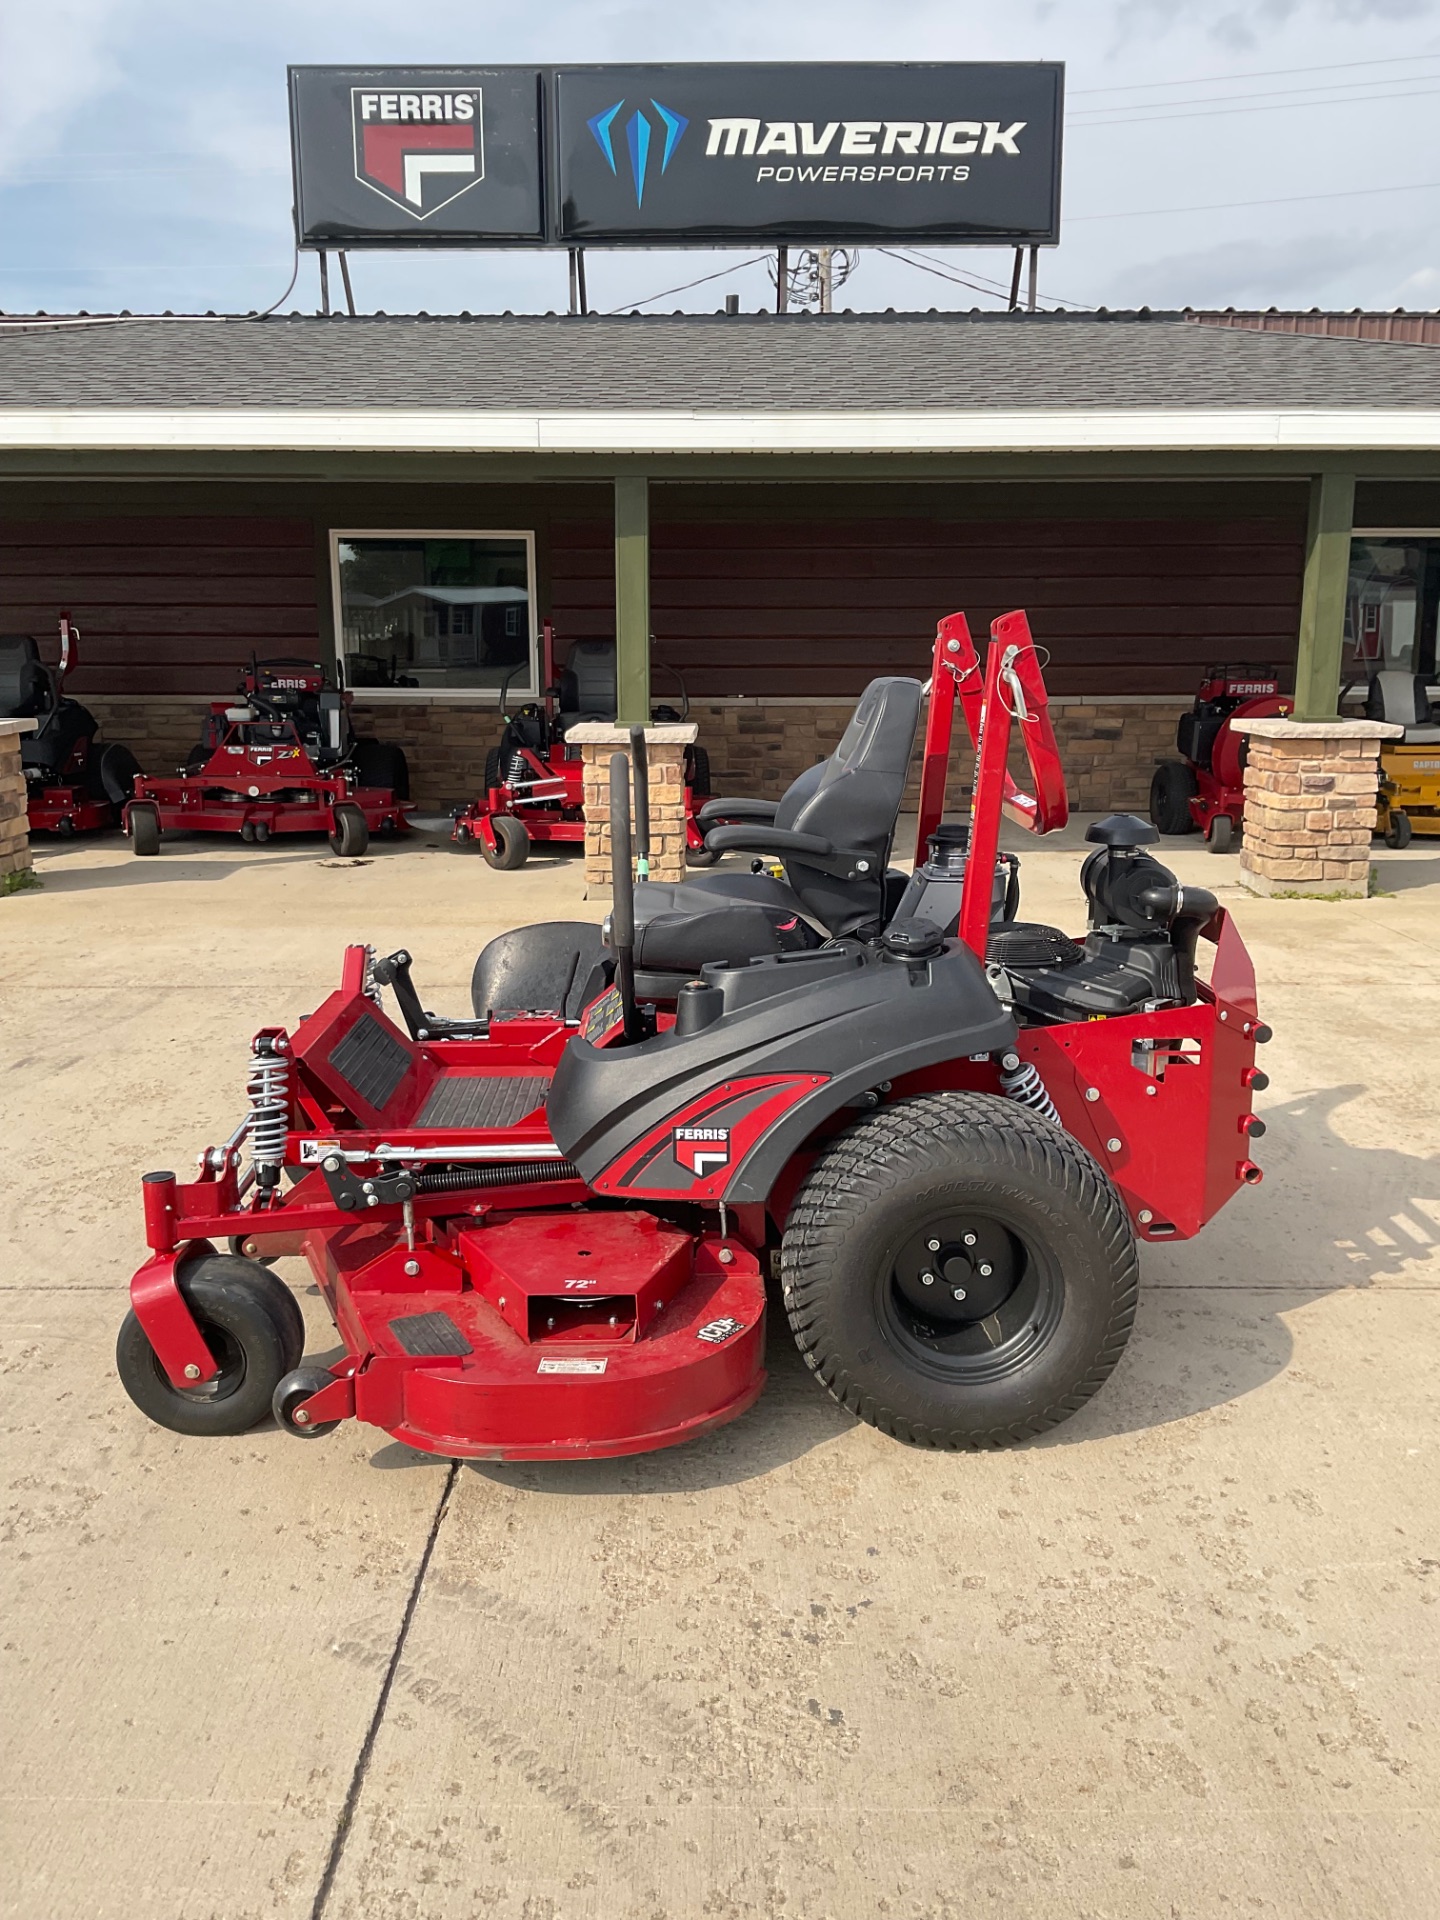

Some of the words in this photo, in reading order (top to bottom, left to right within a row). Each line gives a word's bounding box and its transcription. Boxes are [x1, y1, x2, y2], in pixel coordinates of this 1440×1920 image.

[361, 94, 475, 120] FERRIS
[705, 118, 1028, 155] MAVERICK
[757, 166, 970, 182] POWERSPORTS
[270, 679, 307, 689] ERRIS
[1229, 684, 1274, 694] FERRIS
[1413, 761, 1440, 769] RAPTO
[675, 1128, 728, 1140] FERRIS
[914, 1180, 997, 1204] MULTI
[564, 1279, 597, 1289] 72"
